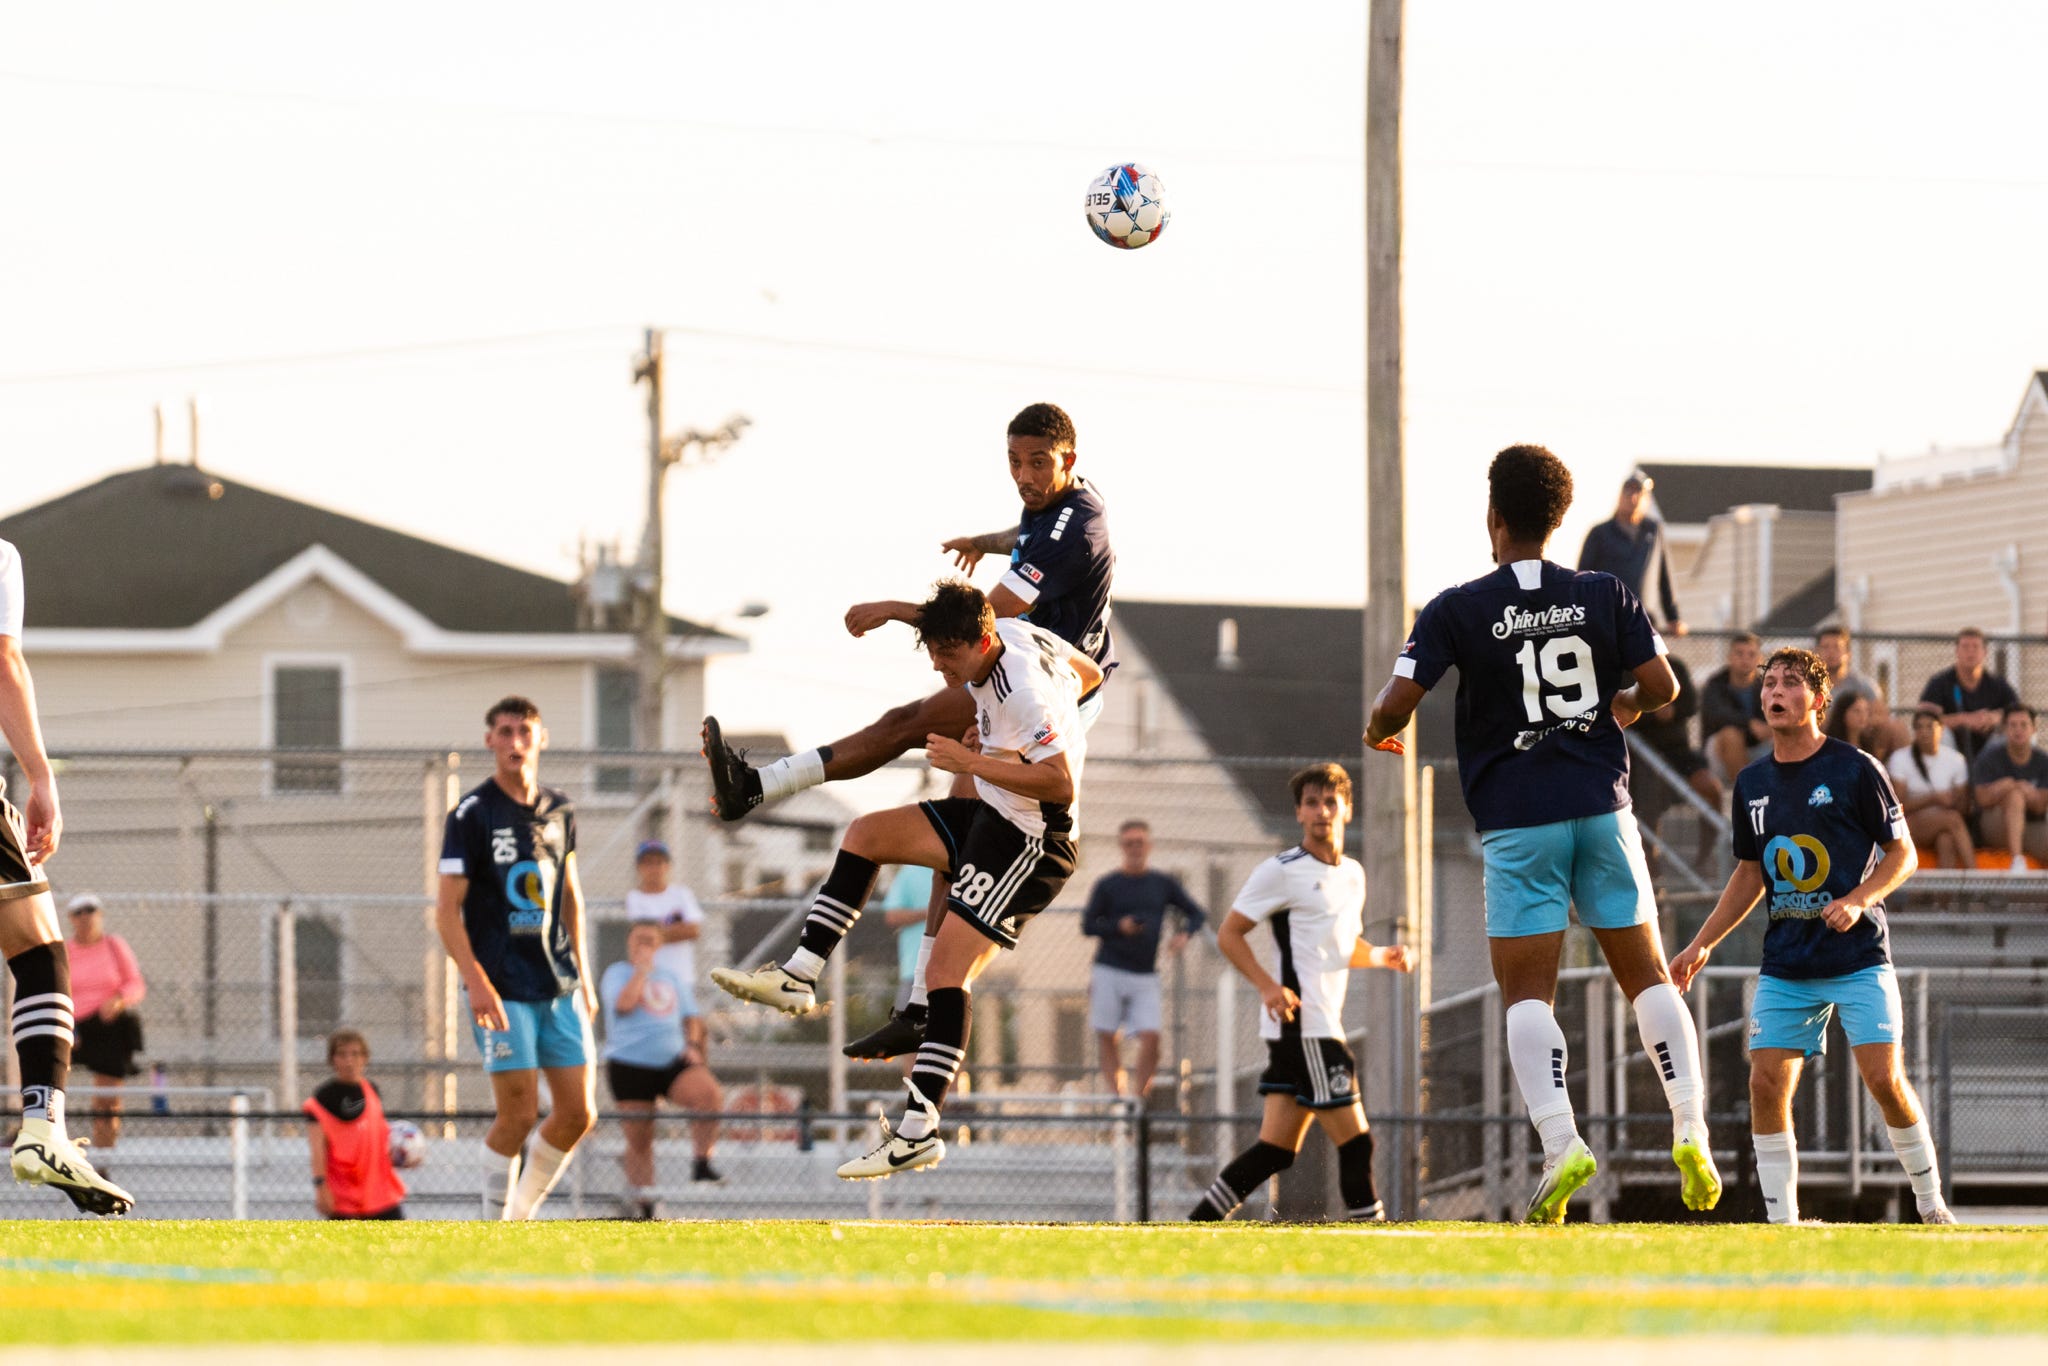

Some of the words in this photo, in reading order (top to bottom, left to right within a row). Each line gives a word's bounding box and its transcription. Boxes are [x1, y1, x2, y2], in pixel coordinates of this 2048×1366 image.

[1492, 604, 1585, 639] SHRIVER'S
[1515, 635, 1599, 723] 19
[1751, 806, 1765, 836] 11
[492, 837, 518, 863] 25
[951, 863, 994, 906] 28
